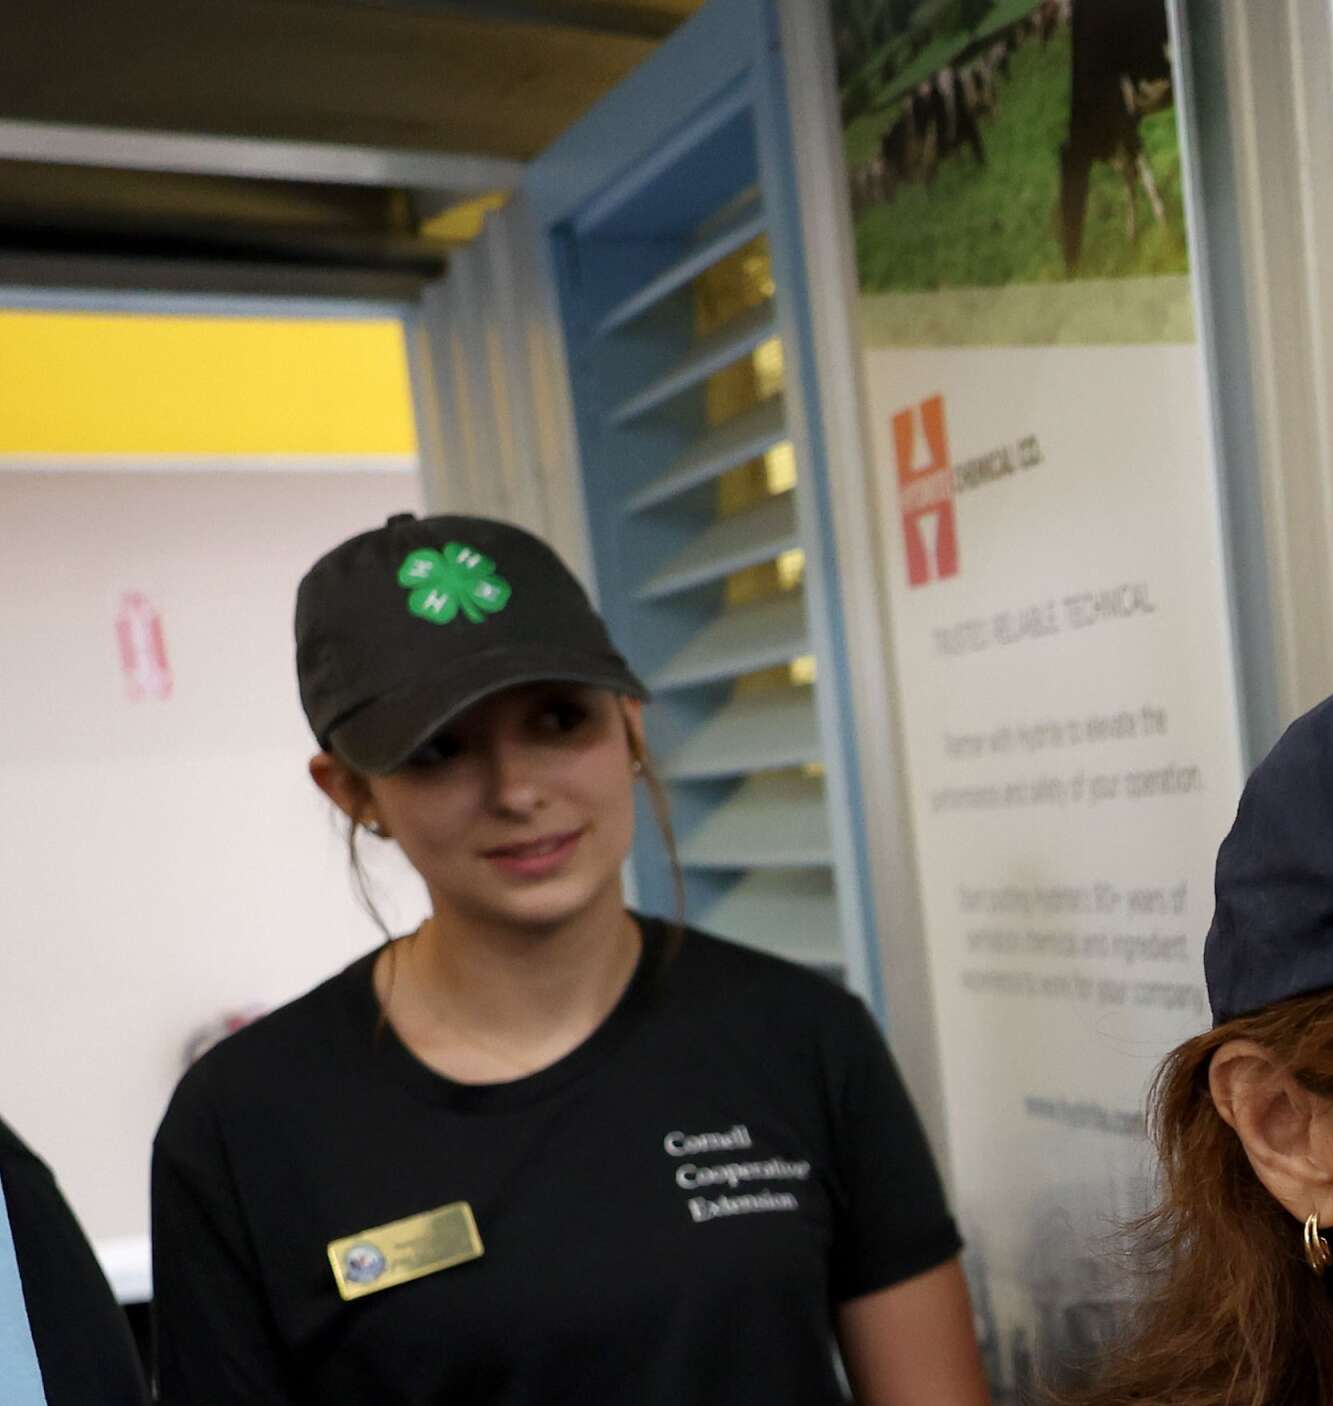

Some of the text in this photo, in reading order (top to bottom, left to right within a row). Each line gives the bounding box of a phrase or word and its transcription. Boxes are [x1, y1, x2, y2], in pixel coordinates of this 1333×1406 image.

[664, 1124, 752, 1157] Cornell
[676, 1159, 811, 1190] Cooperative
[688, 1189, 799, 1223] Extension
